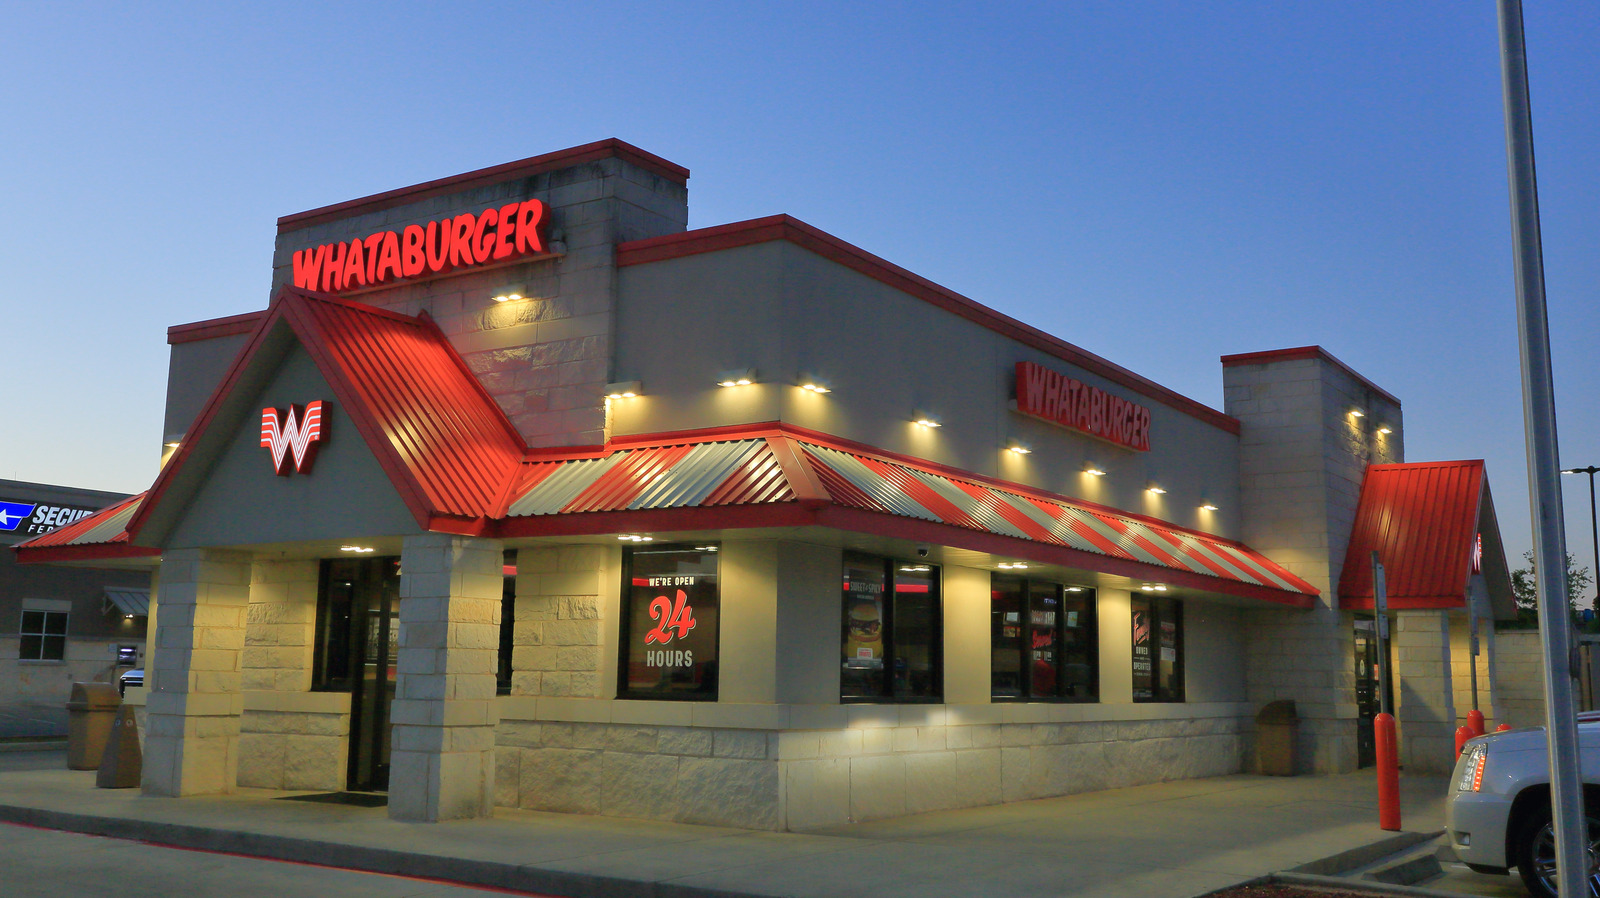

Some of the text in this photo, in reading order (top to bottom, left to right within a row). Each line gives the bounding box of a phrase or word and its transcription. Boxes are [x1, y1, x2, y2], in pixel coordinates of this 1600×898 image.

[292, 199, 543, 293] WHATABURGER
[1024, 361, 1151, 452] WHATABURGER
[261, 400, 324, 476] W
[649, 576, 694, 587] WE'RE OPEN
[850, 581, 866, 592] SWEET
[644, 589, 696, 645] 24
[646, 650, 693, 667] HOURS
